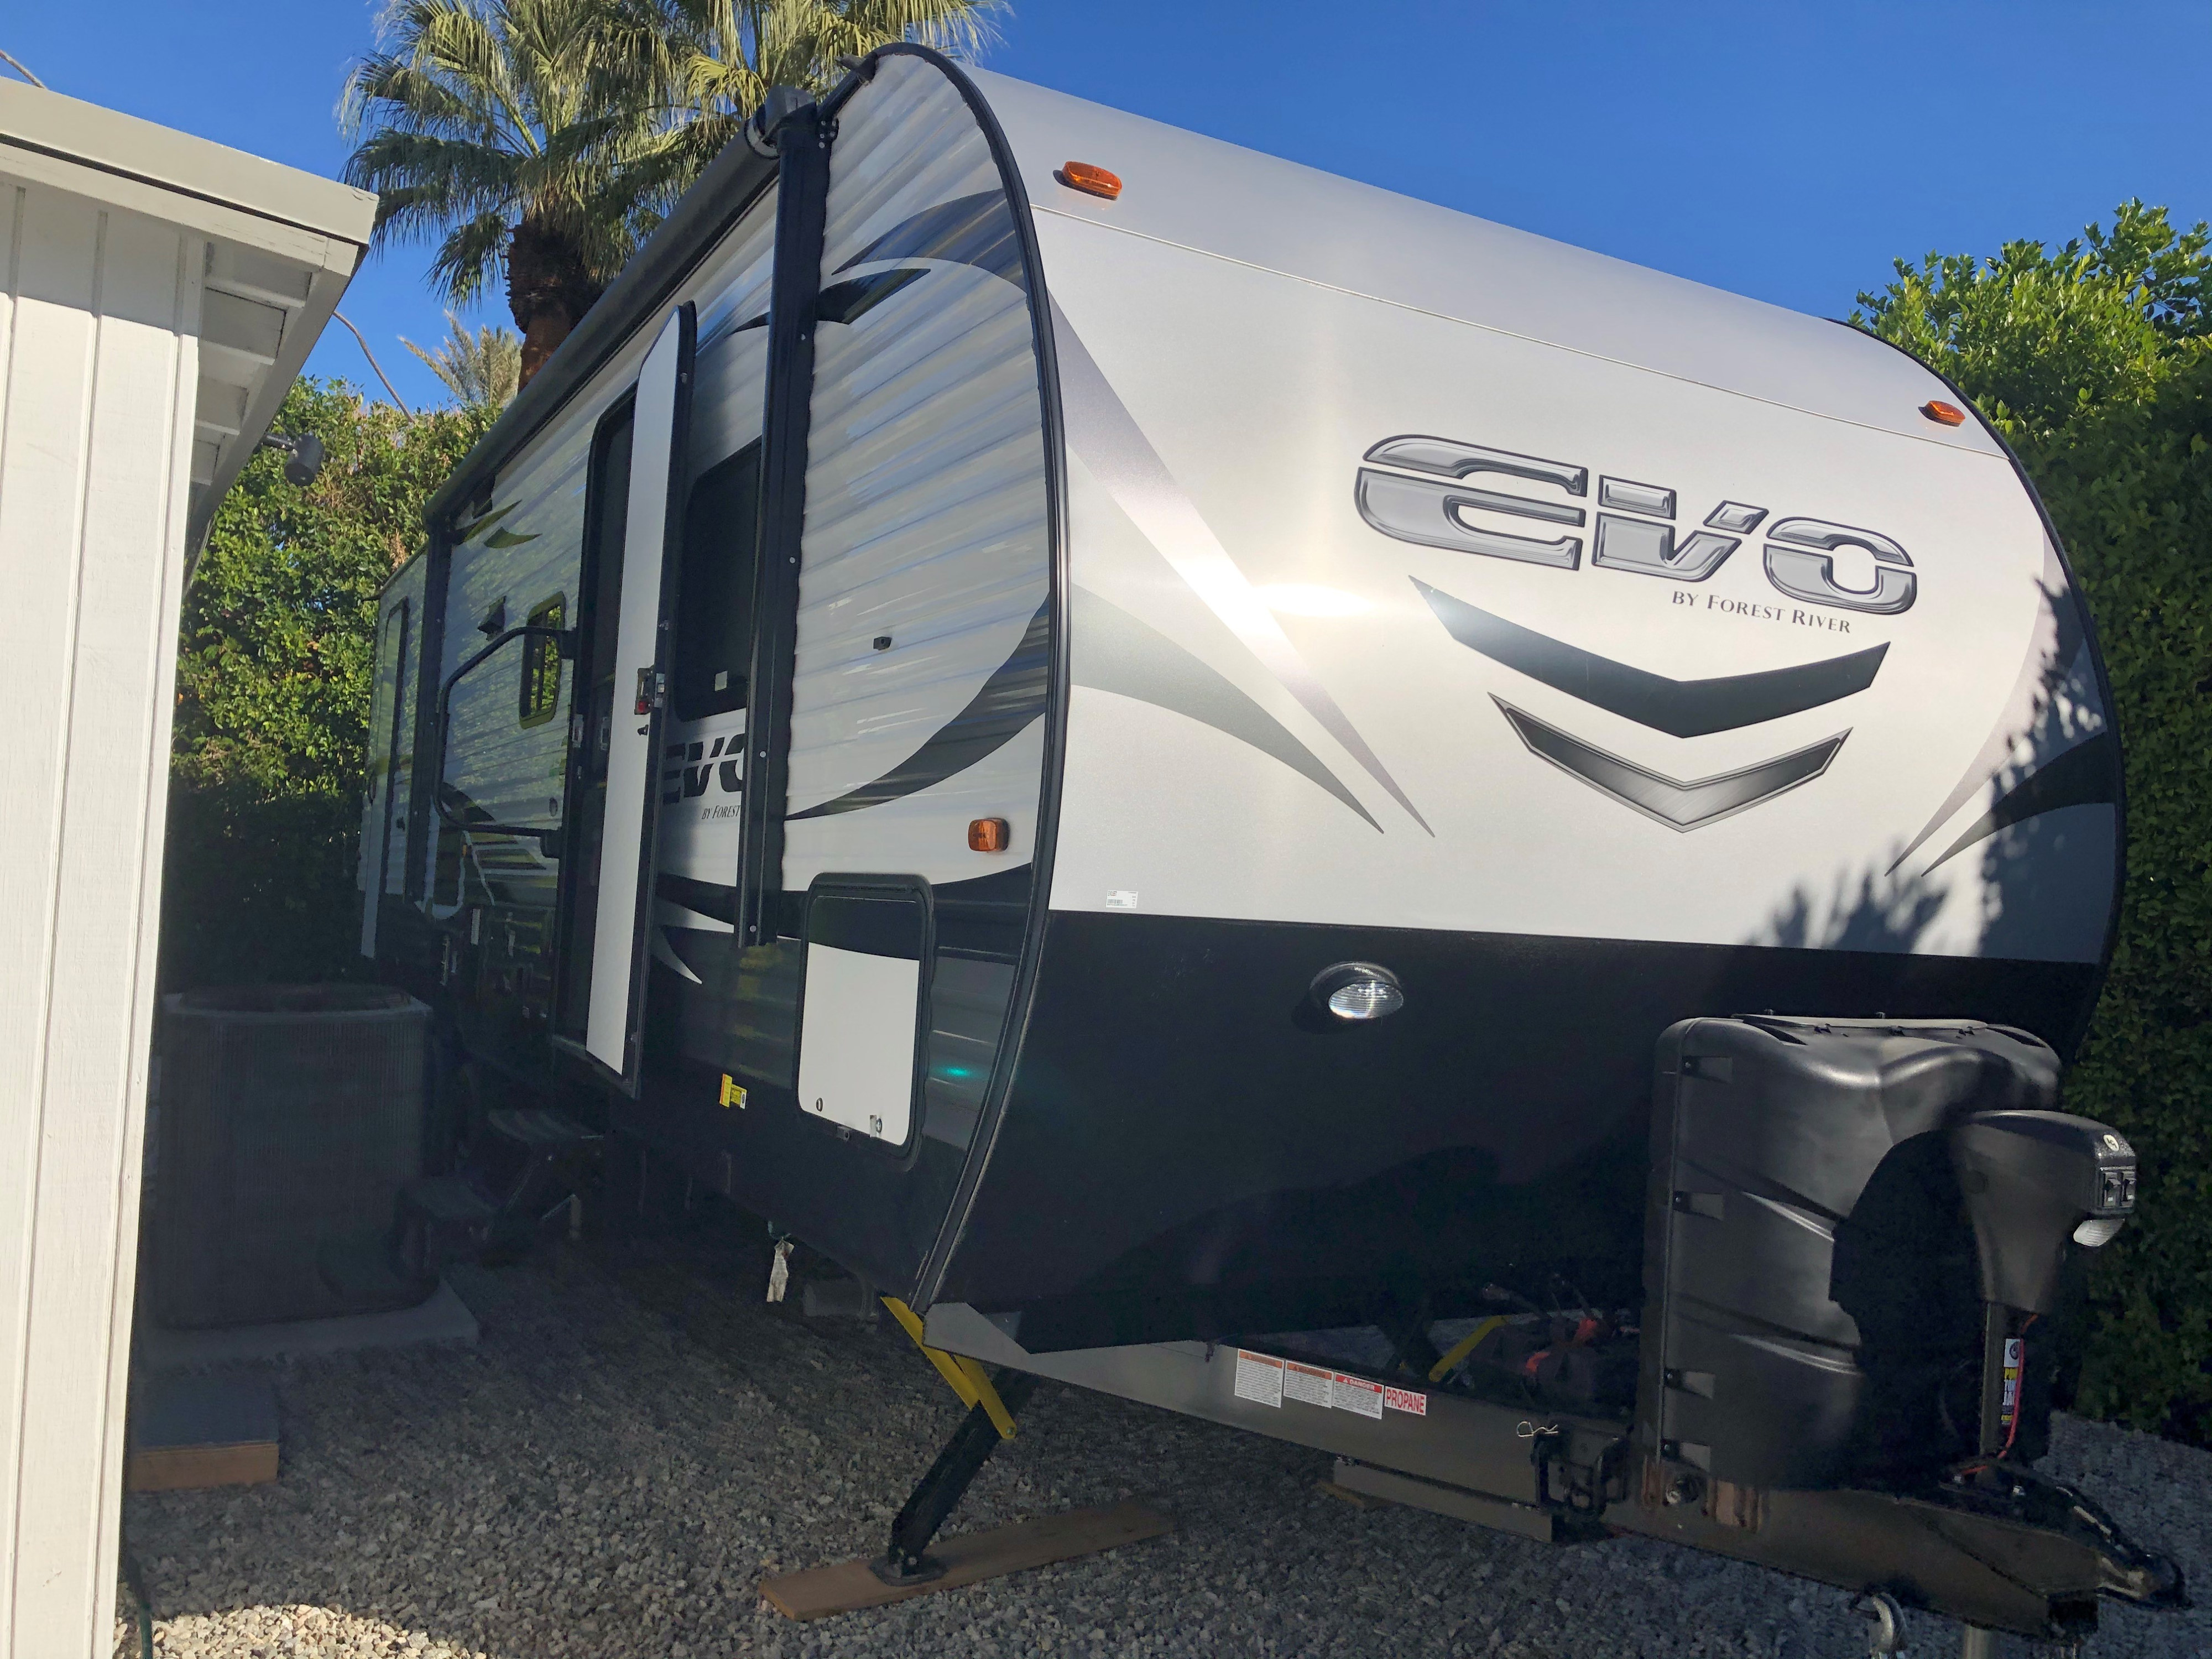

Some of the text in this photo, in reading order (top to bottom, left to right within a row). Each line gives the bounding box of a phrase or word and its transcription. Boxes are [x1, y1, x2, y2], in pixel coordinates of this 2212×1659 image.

[1353, 434, 1917, 616] EVO
[1672, 591, 1850, 633] BY FOREST RIVER
[701, 805, 741, 820] BY FOREST
[1386, 1389, 1425, 1413] PROPANE
